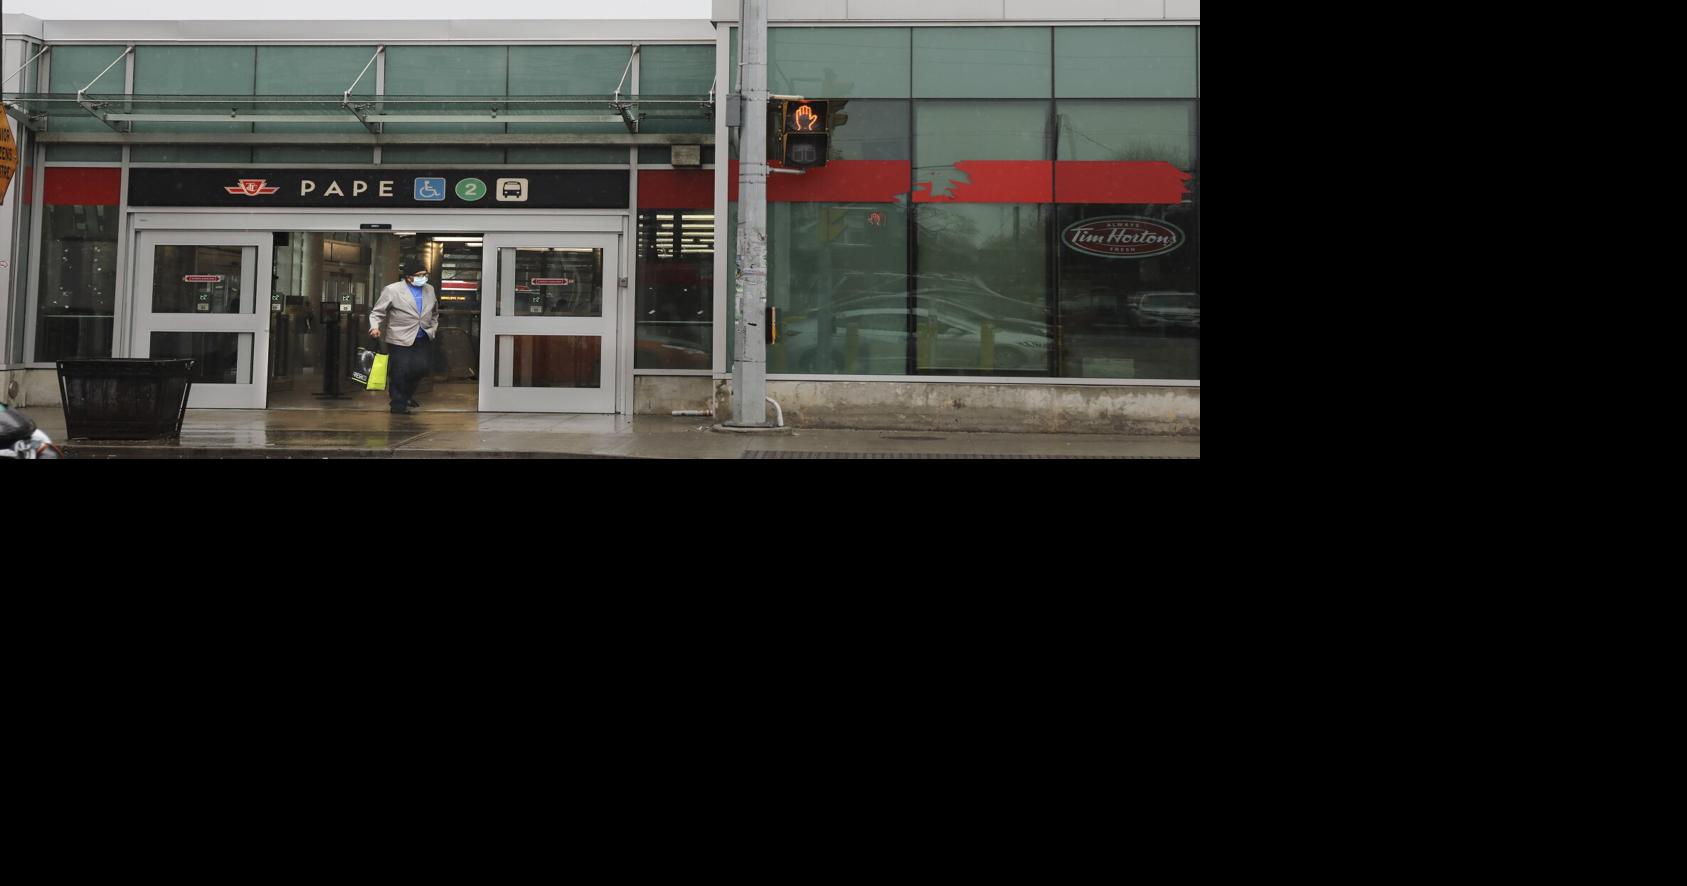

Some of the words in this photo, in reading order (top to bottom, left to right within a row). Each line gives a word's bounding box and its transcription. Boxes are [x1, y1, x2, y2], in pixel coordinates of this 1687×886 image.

[301, 180, 394, 197] PAPE
[464, 183, 477, 196] 2
[1069, 227, 1105, 243] Tim
[1107, 227, 1177, 246] Hortons
